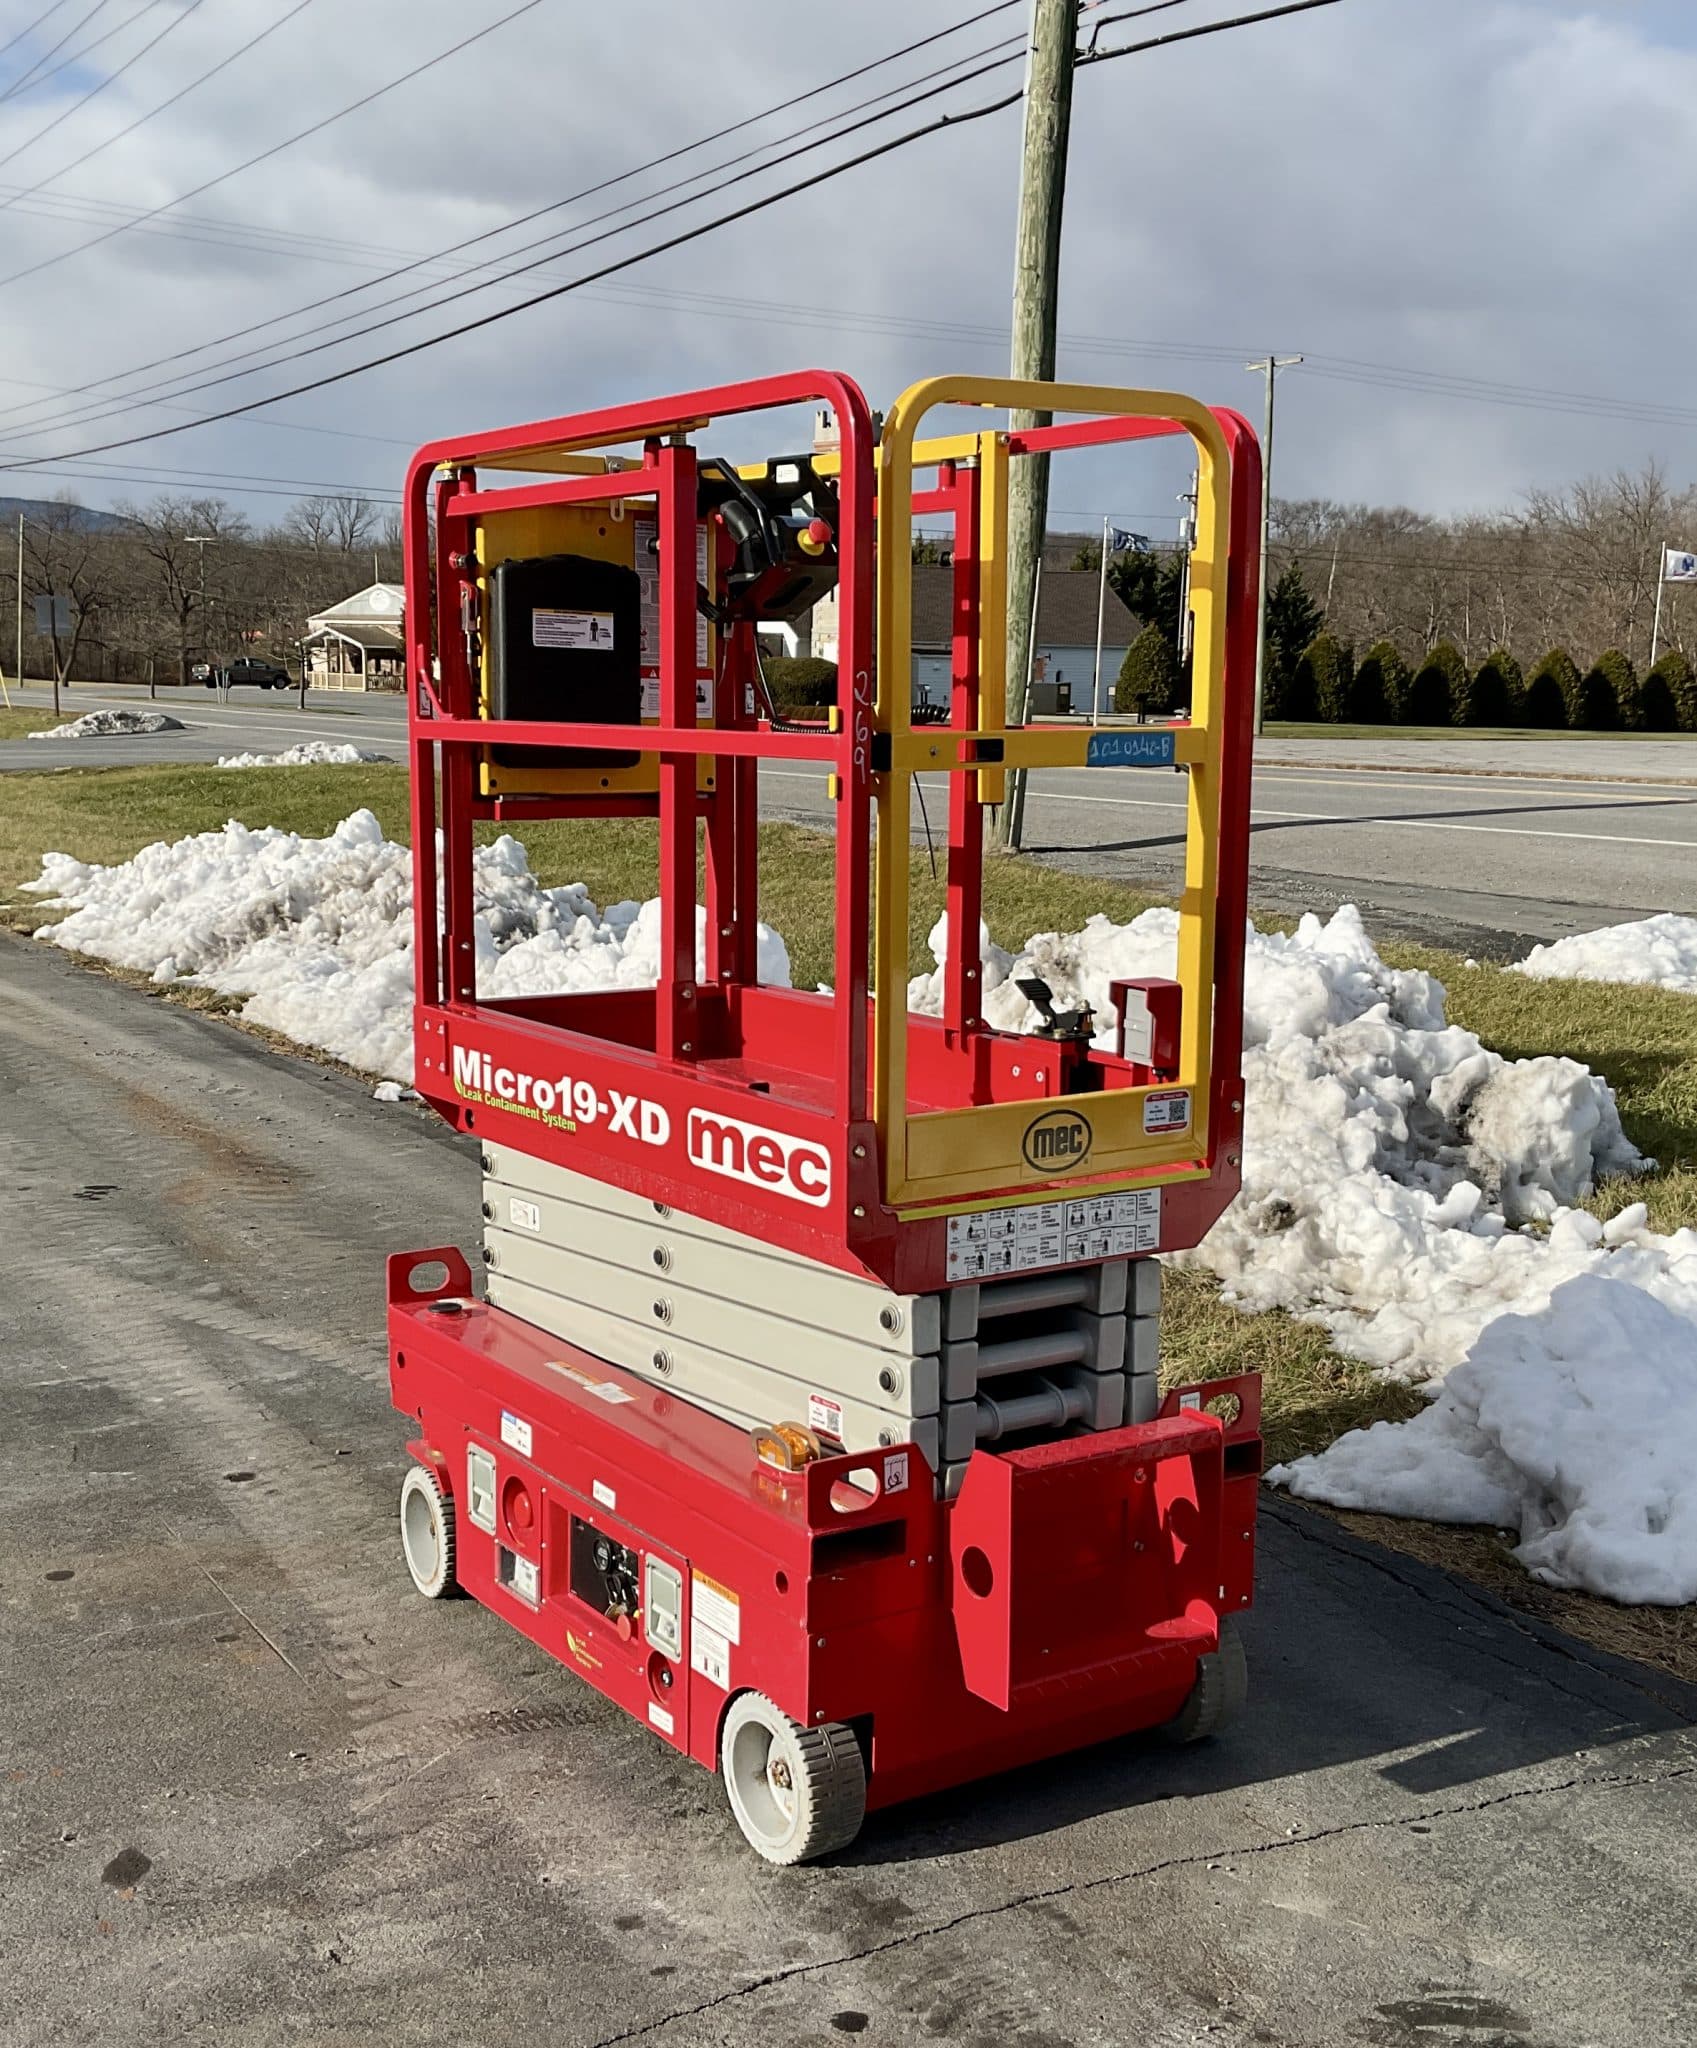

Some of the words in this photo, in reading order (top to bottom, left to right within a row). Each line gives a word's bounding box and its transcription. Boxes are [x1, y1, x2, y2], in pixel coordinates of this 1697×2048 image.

[453, 1044, 671, 1146] Micro19-XD
[463, 1085, 482, 1102] Leak
[484, 1092, 540, 1121] Containment
[542, 1108, 577, 1132] System
